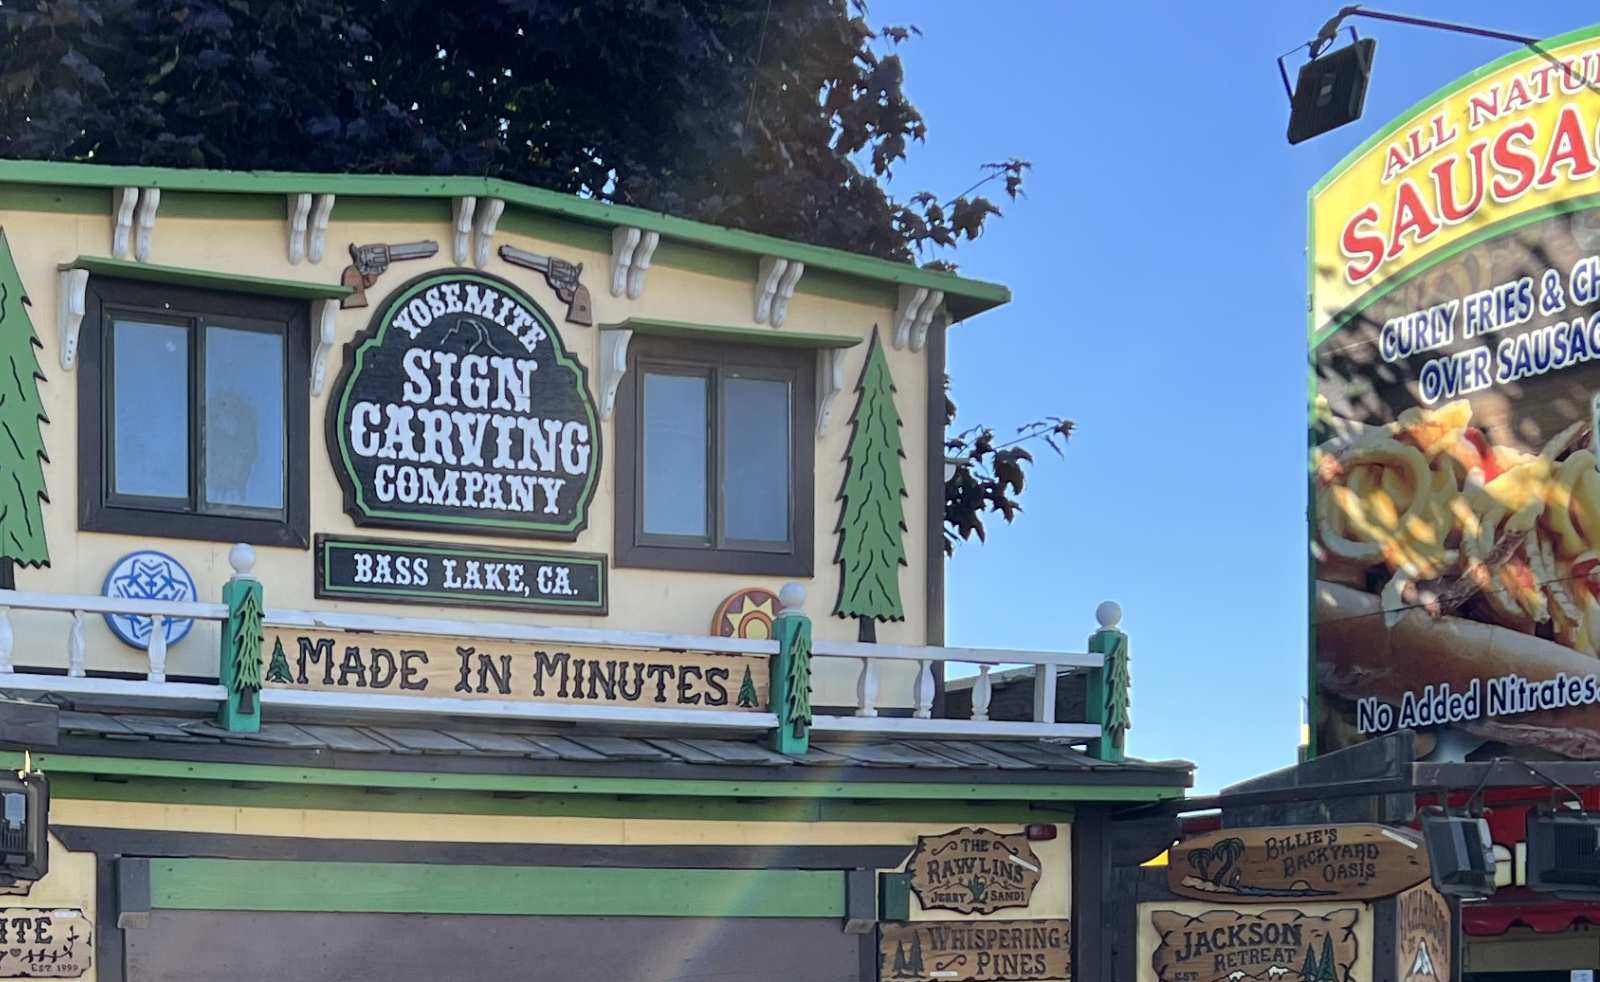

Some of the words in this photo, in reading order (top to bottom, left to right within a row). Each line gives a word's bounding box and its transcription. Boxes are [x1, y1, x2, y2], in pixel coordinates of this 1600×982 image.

[1383, 114, 1457, 183] ALL
[393, 283, 548, 353] YOSEMITE
[1379, 299, 1457, 363] CURLY
[1463, 278, 1533, 339] FRIES
[402, 348, 538, 412] SIGN
[1419, 345, 1492, 404] OVER
[350, 402, 590, 475] CARVING
[374, 464, 566, 514] COMPANY
[354, 552, 429, 586] BASS
[441, 559, 530, 597] LAKE,
[536, 565, 579, 596] CA.
[297, 636, 429, 692] MADE
[455, 646, 512, 695] IN
[533, 652, 729, 706] MINUTES
[1358, 698, 1392, 733] No
[1399, 678, 1481, 729] Added
[960, 839, 990, 852] THE
[1264, 828, 1338, 861] BILLIE'S
[1282, 843, 1380, 879] BACKYARD
[927, 857, 1024, 884] RAWLINS
[1322, 862, 1376, 883] OASIS
[926, 927, 1061, 951] WHISPERING
[1175, 923, 1304, 963] JACKSON
[1214, 948, 1297, 975] RETREAT
[976, 951, 1046, 976] PINES
